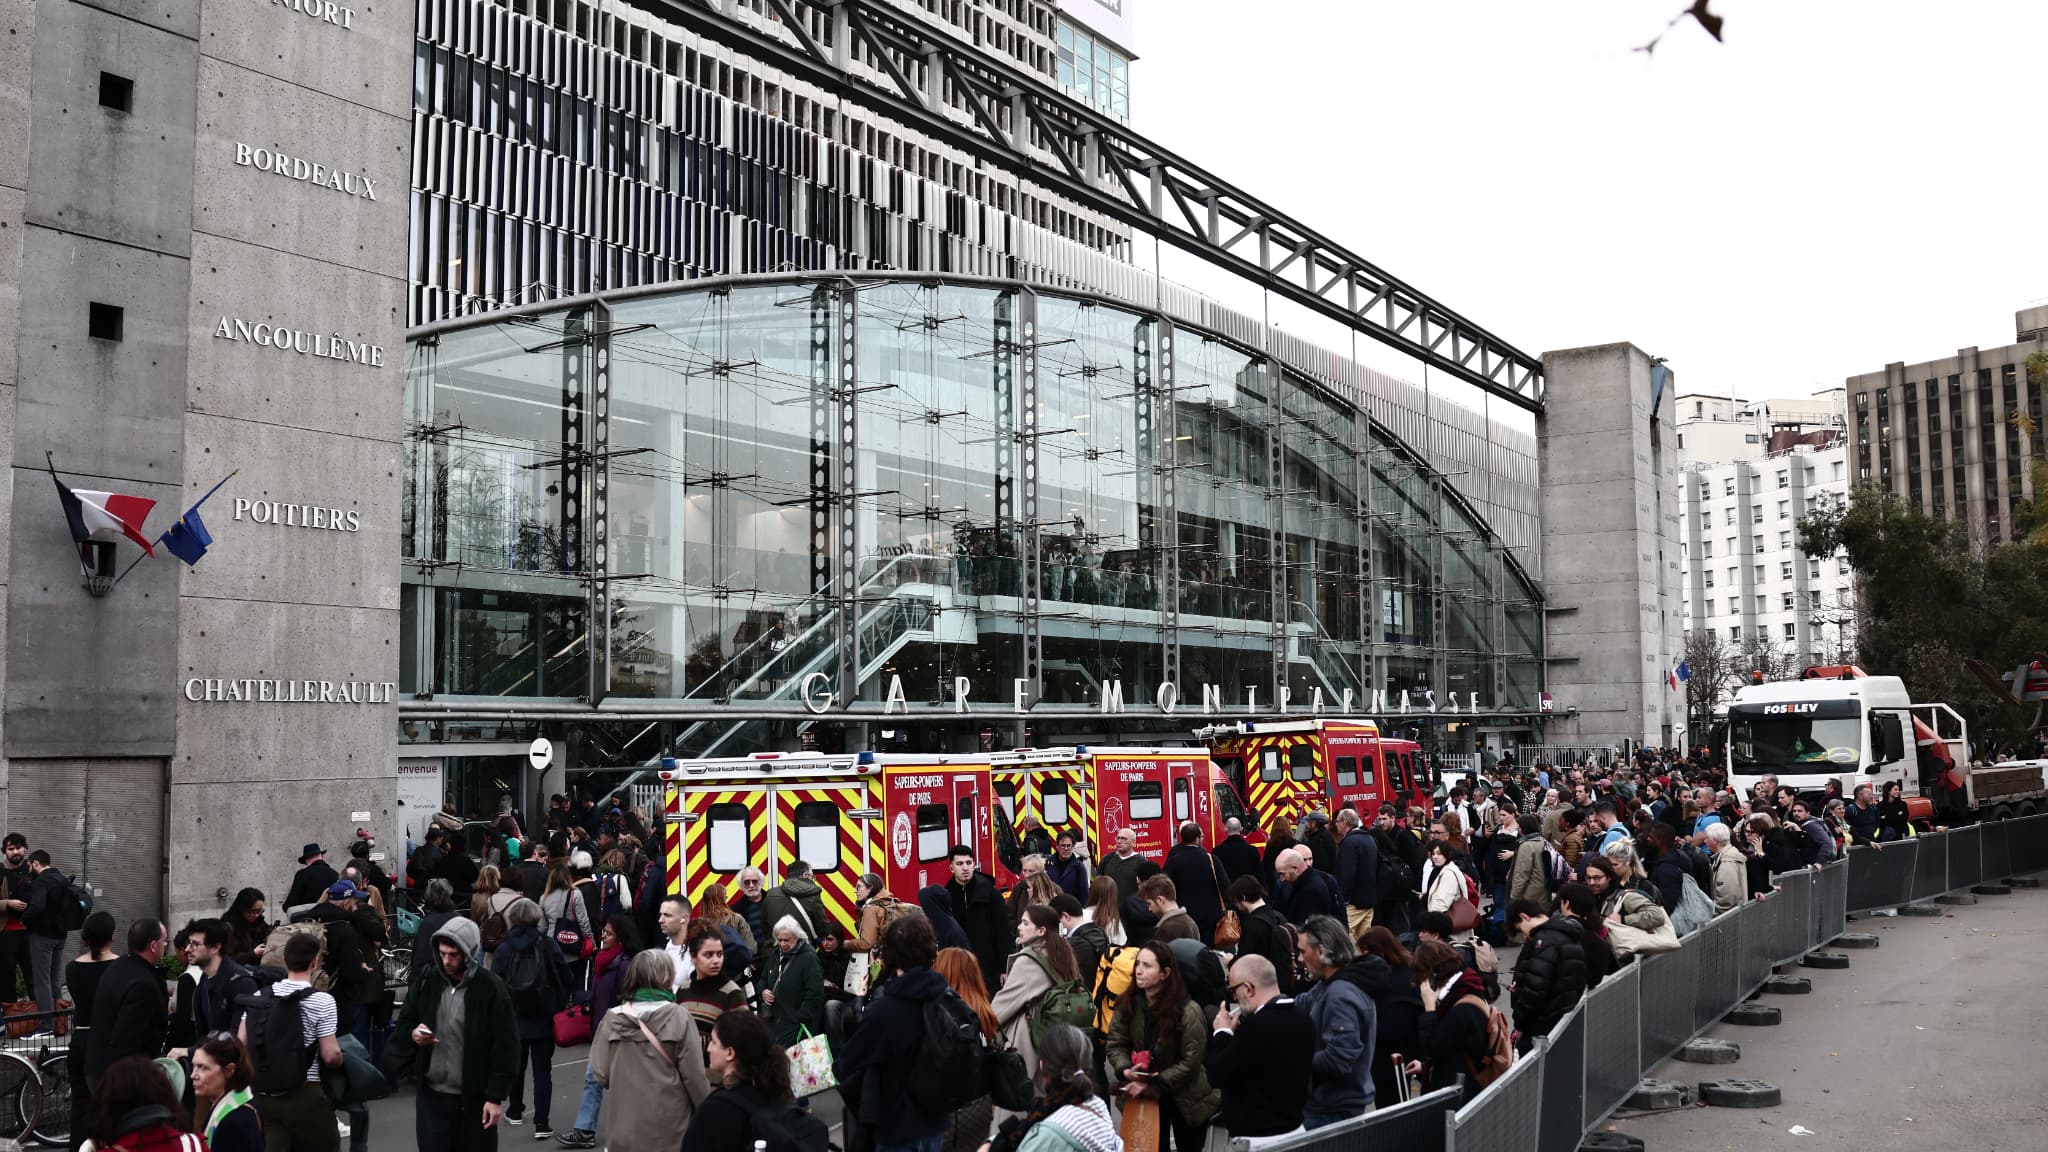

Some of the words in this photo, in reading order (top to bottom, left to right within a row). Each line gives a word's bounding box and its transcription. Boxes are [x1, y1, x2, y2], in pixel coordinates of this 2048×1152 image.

[234, 142, 377, 201] BORDEAUX
[214, 315, 385, 367] ANGOULÊME
[233, 498, 360, 533] POITIERS
[184, 678, 395, 704] CHATELLERAULT
[800, 673, 1030, 714] GARE
[1101, 679, 1481, 714] MONTPARNASSE
[1104, 761, 1157, 770] SAPEURS-POMPIERS
[1120, 773, 1128, 781] DE
[1128, 773, 1144, 782] PARIS
[894, 774, 944, 790] SAPEURS-POMPIERS
[908, 792, 917, 806] DE
[916, 791, 932, 805] PARIS
